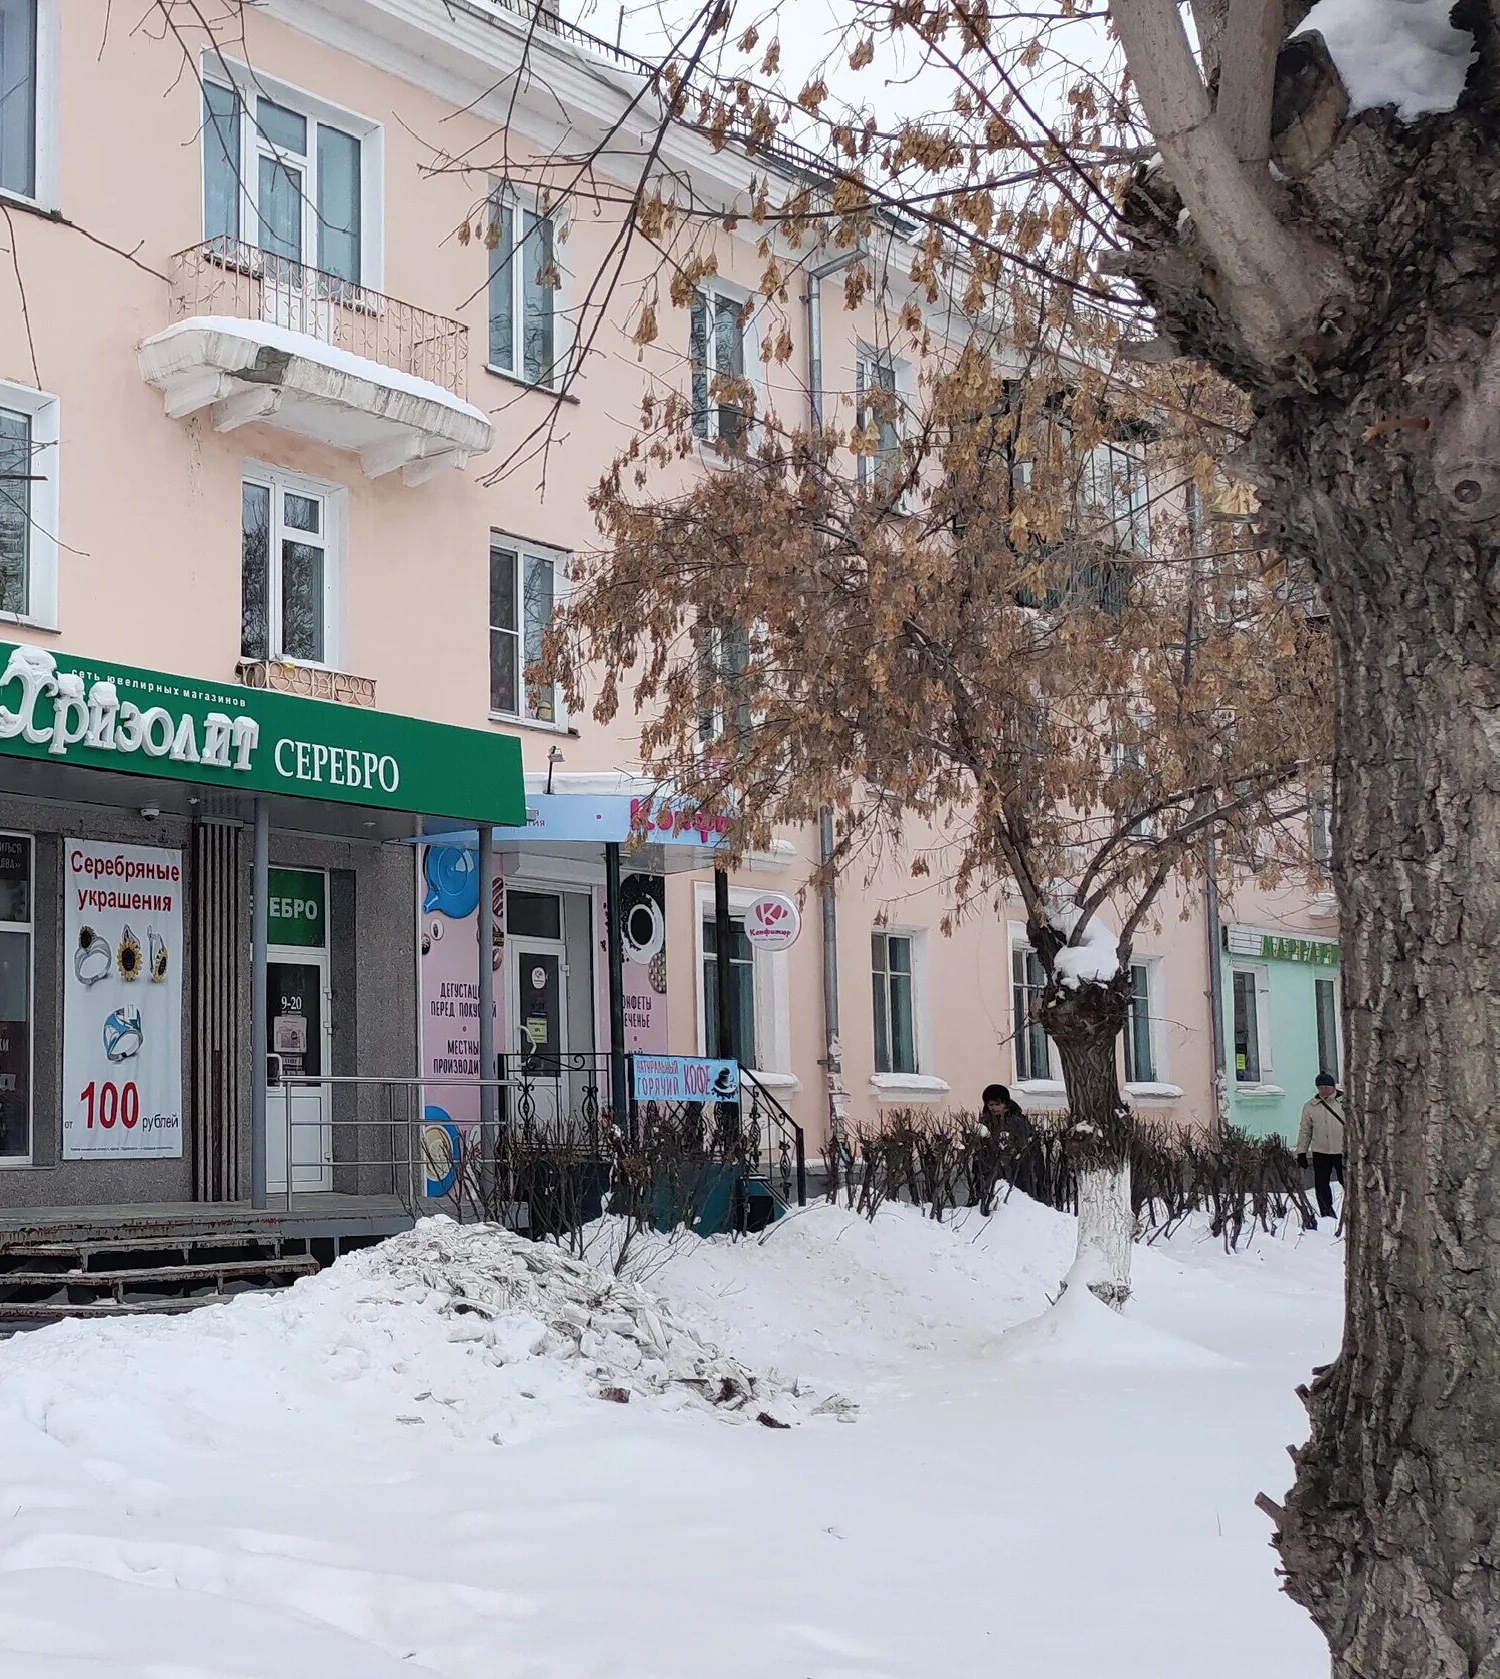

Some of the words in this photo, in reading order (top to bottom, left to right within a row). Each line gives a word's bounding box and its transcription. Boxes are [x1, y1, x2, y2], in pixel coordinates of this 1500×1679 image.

[72, 669, 100, 681] сеть
[107, 675, 179, 696] ювелирных
[183, 689, 246, 707] магазинов
[273, 738, 399, 793] СЕРЕБРО
[71, 850, 179, 881] Серебряные
[78, 888, 172, 912] украшения
[440, 983, 480, 1000] ДЕГУСТАЦ
[281, 996, 302, 1010] 9-20
[431, 1001, 455, 1017] ПЕРЕД
[622, 996, 652, 1010] ОНФЕТЫ
[624, 1013, 650, 1028] ЕЧЕНЬЕ
[448, 1040, 479, 1055] МЕСТНЫ
[684, 1064, 711, 1095] КОФЕ
[80, 1081, 139, 1129] 100
[64, 1121, 73, 1129] от
[142, 1113, 179, 1133] рублей
